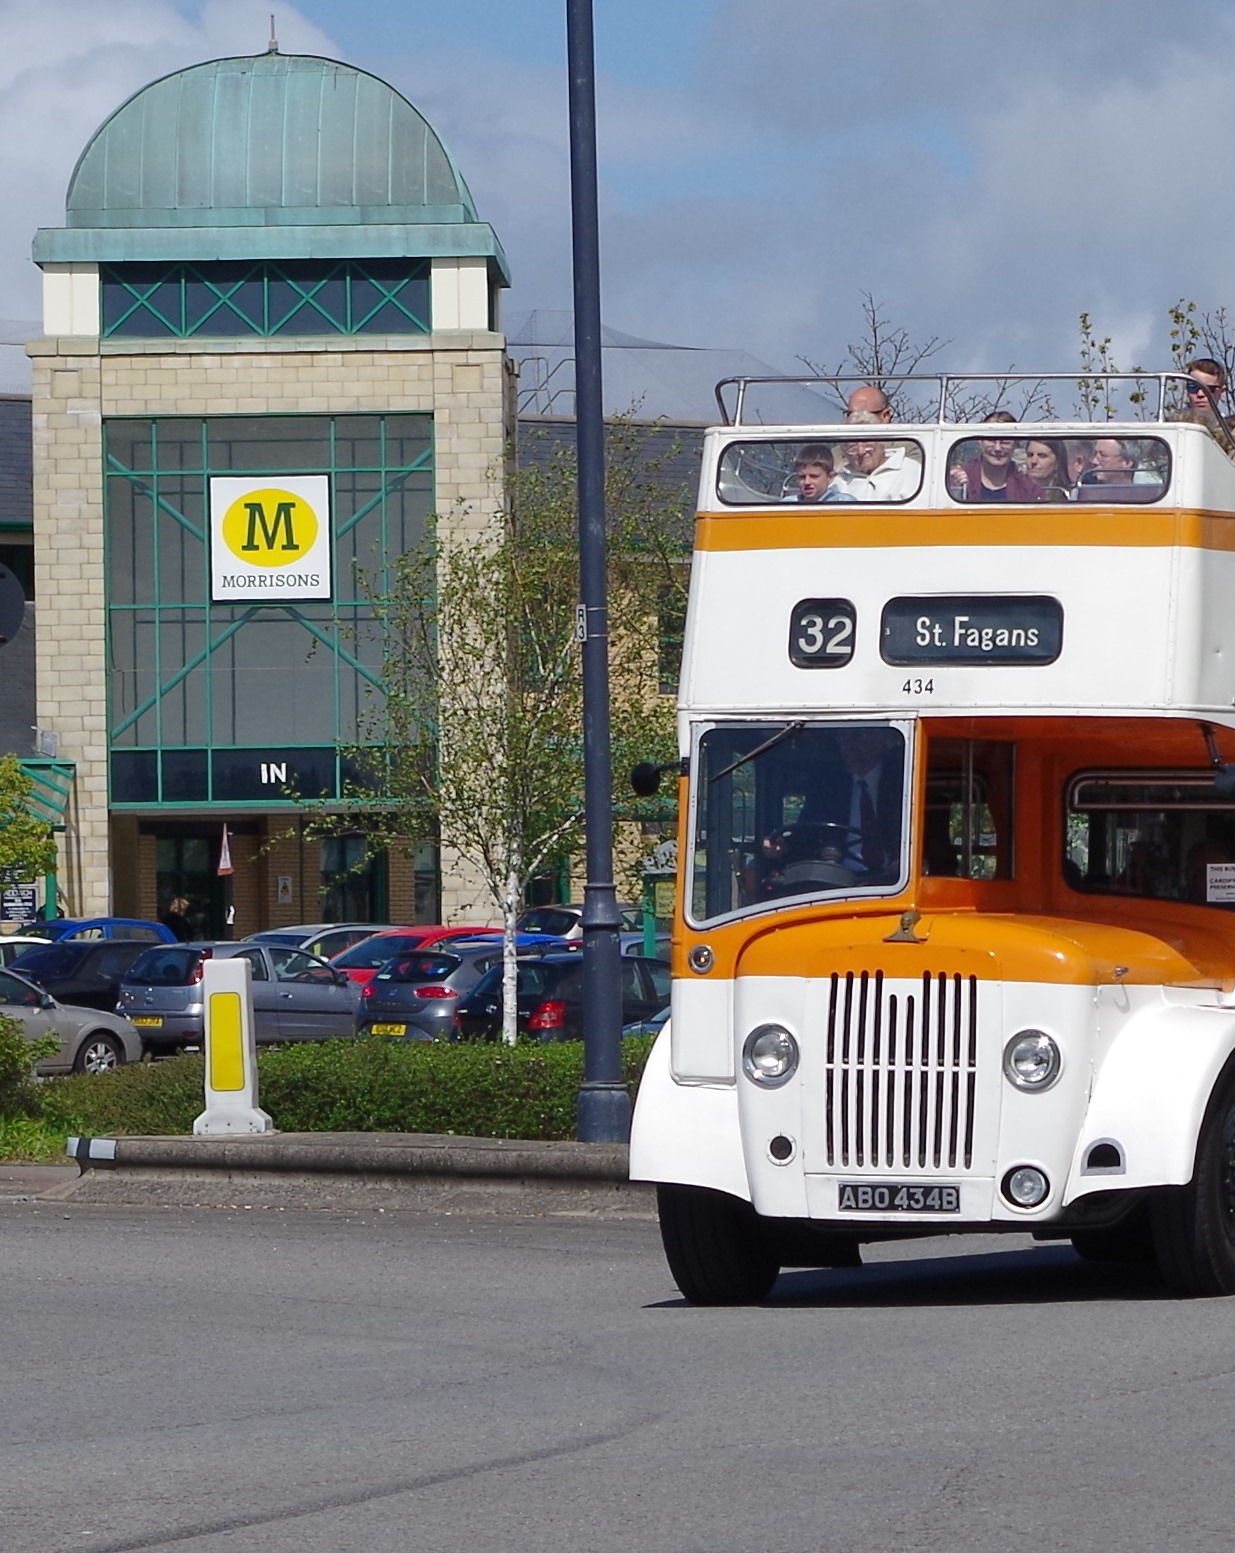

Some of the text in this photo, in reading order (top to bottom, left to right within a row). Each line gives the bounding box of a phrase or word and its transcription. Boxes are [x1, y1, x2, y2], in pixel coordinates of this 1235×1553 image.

[241, 502, 300, 552] M
[221, 574, 320, 588] MORRISONS
[798, 614, 852, 654] 32
[916, 616, 1039, 651] St. Fagans
[902, 678, 935, 695] 434
[260, 762, 287, 784] IN
[841, 1186, 958, 1210] ABO 434B
